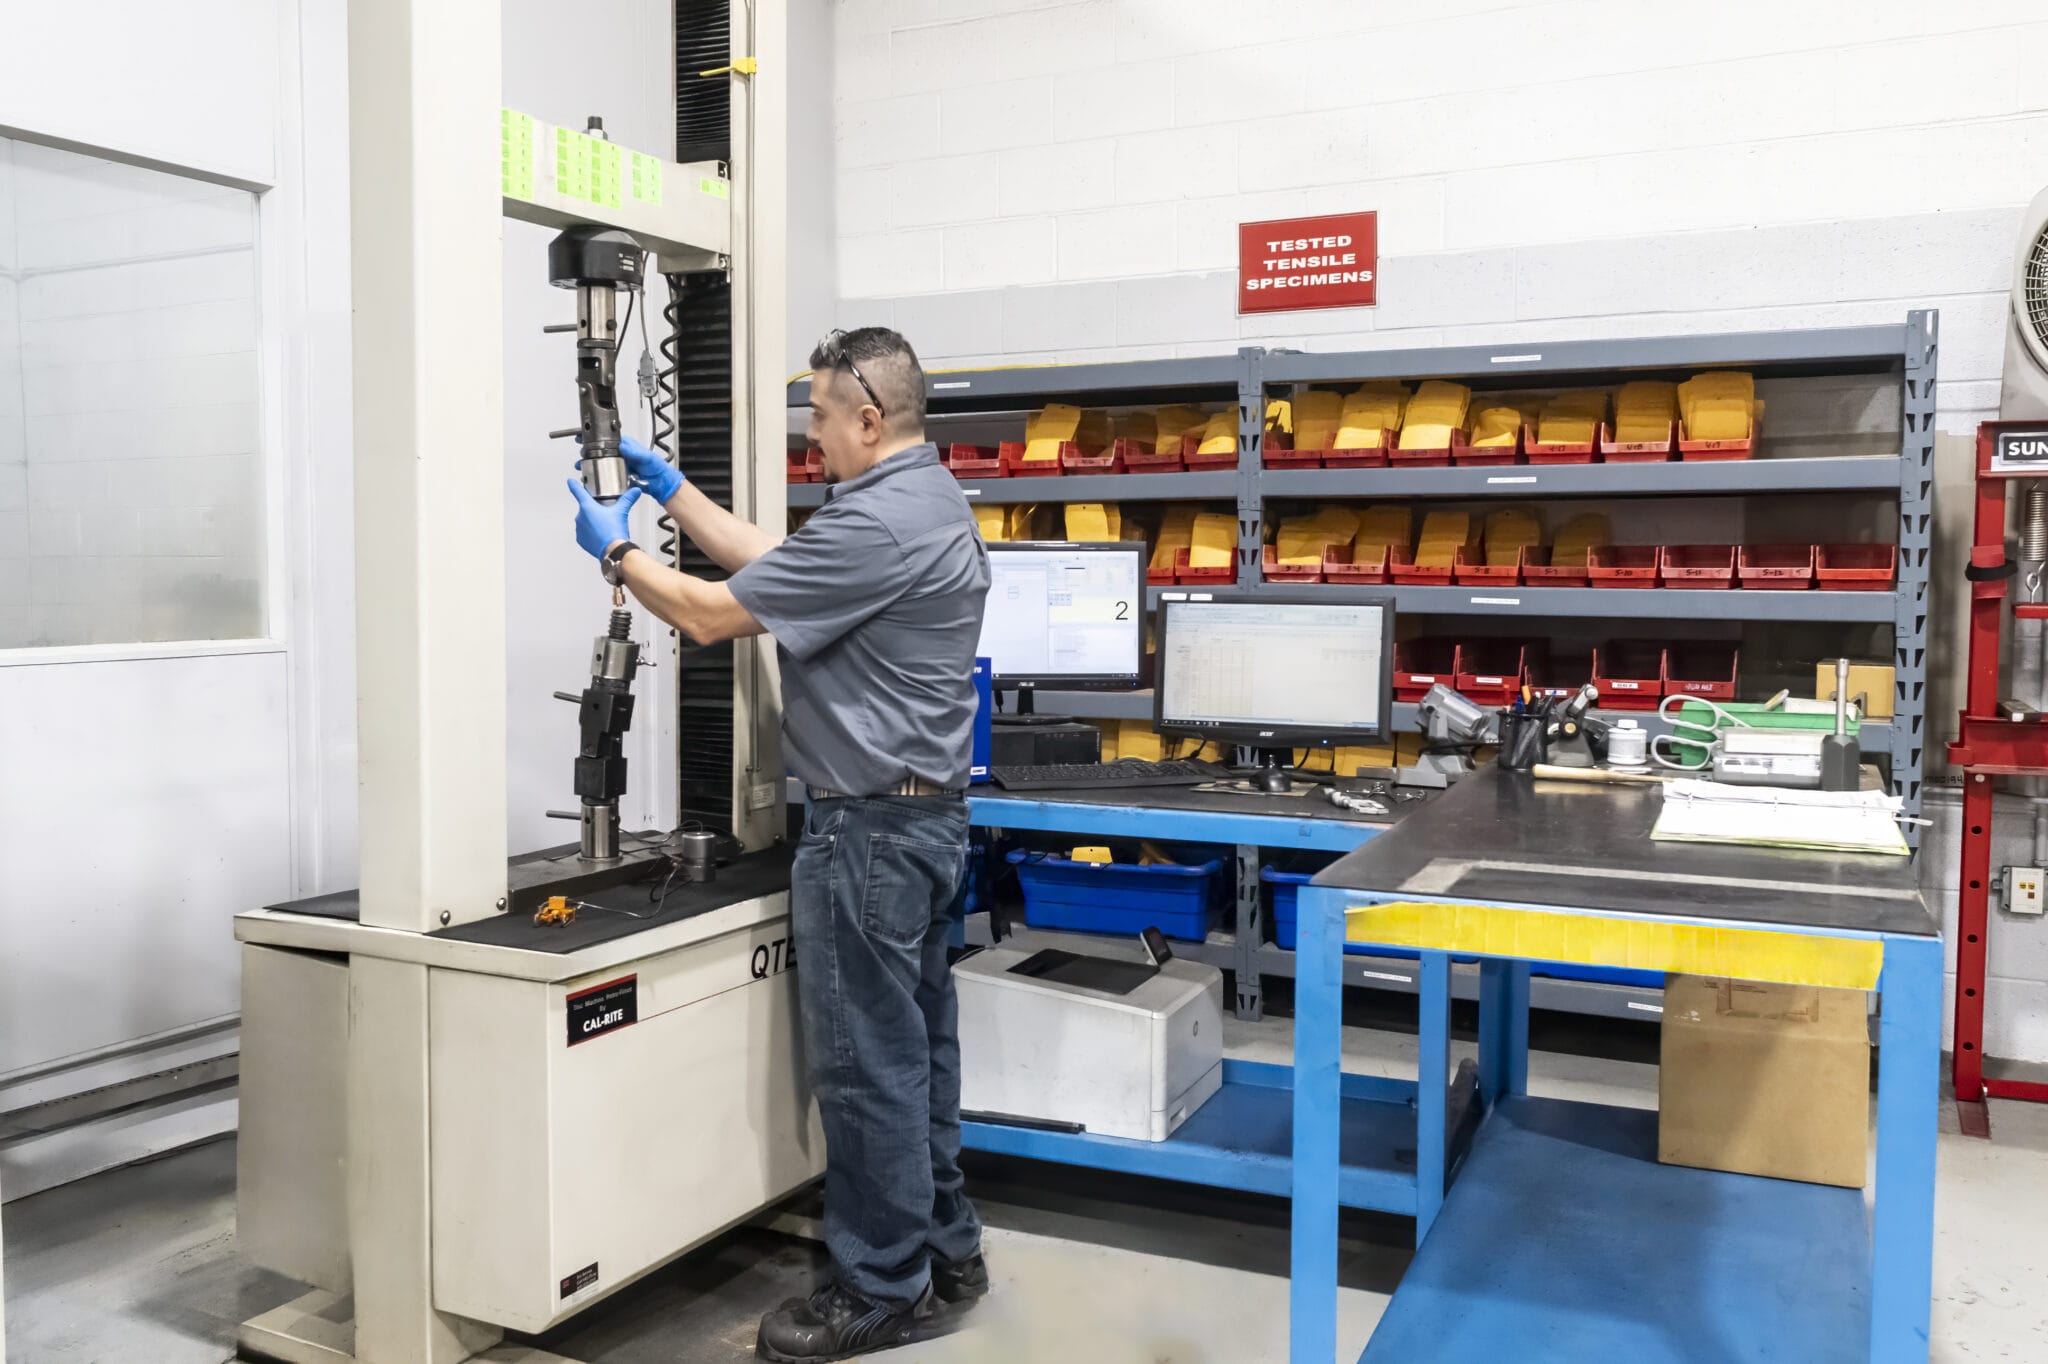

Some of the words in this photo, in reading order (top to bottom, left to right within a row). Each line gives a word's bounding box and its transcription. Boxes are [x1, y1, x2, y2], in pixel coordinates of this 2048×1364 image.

[1267, 235, 1352, 252] TESTED
[1263, 253, 1356, 271] TENSILE
[1246, 270, 1373, 290] SPECIMENS
[1115, 601, 1129, 620] 2
[583, 1008, 624, 1032] CAL-RITE
